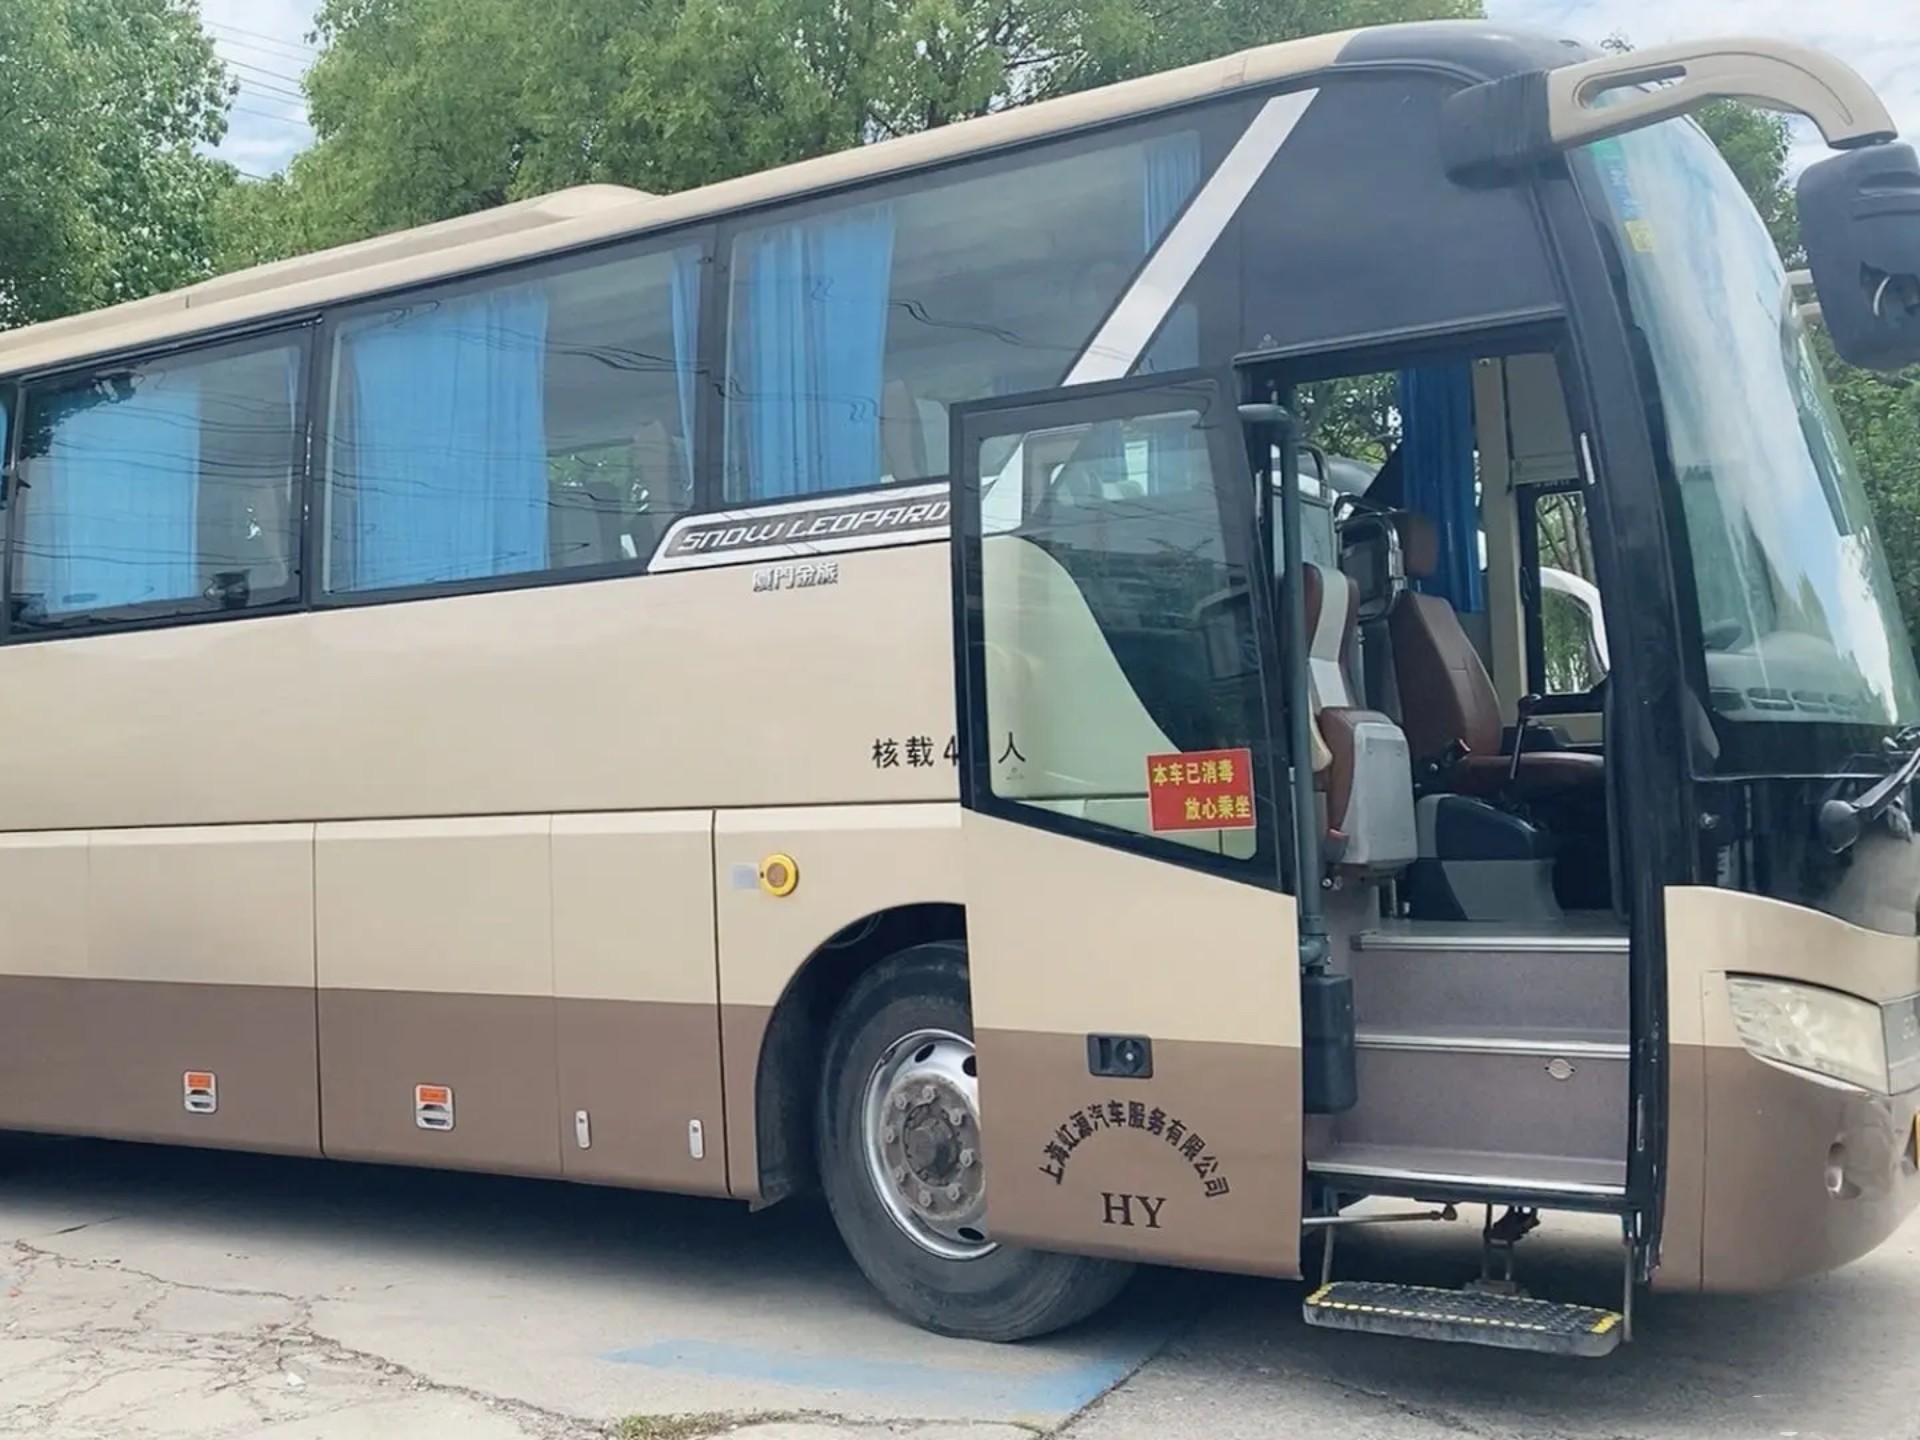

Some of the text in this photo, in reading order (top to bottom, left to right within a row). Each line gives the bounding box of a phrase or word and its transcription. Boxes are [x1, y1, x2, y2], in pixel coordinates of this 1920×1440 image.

[676, 500, 950, 551] SNOW LEOPARD
[1152, 758, 1234, 787] 本车已消毒
[1184, 794, 1252, 821] 放心乘坐
[1100, 1192, 1167, 1229] HY
